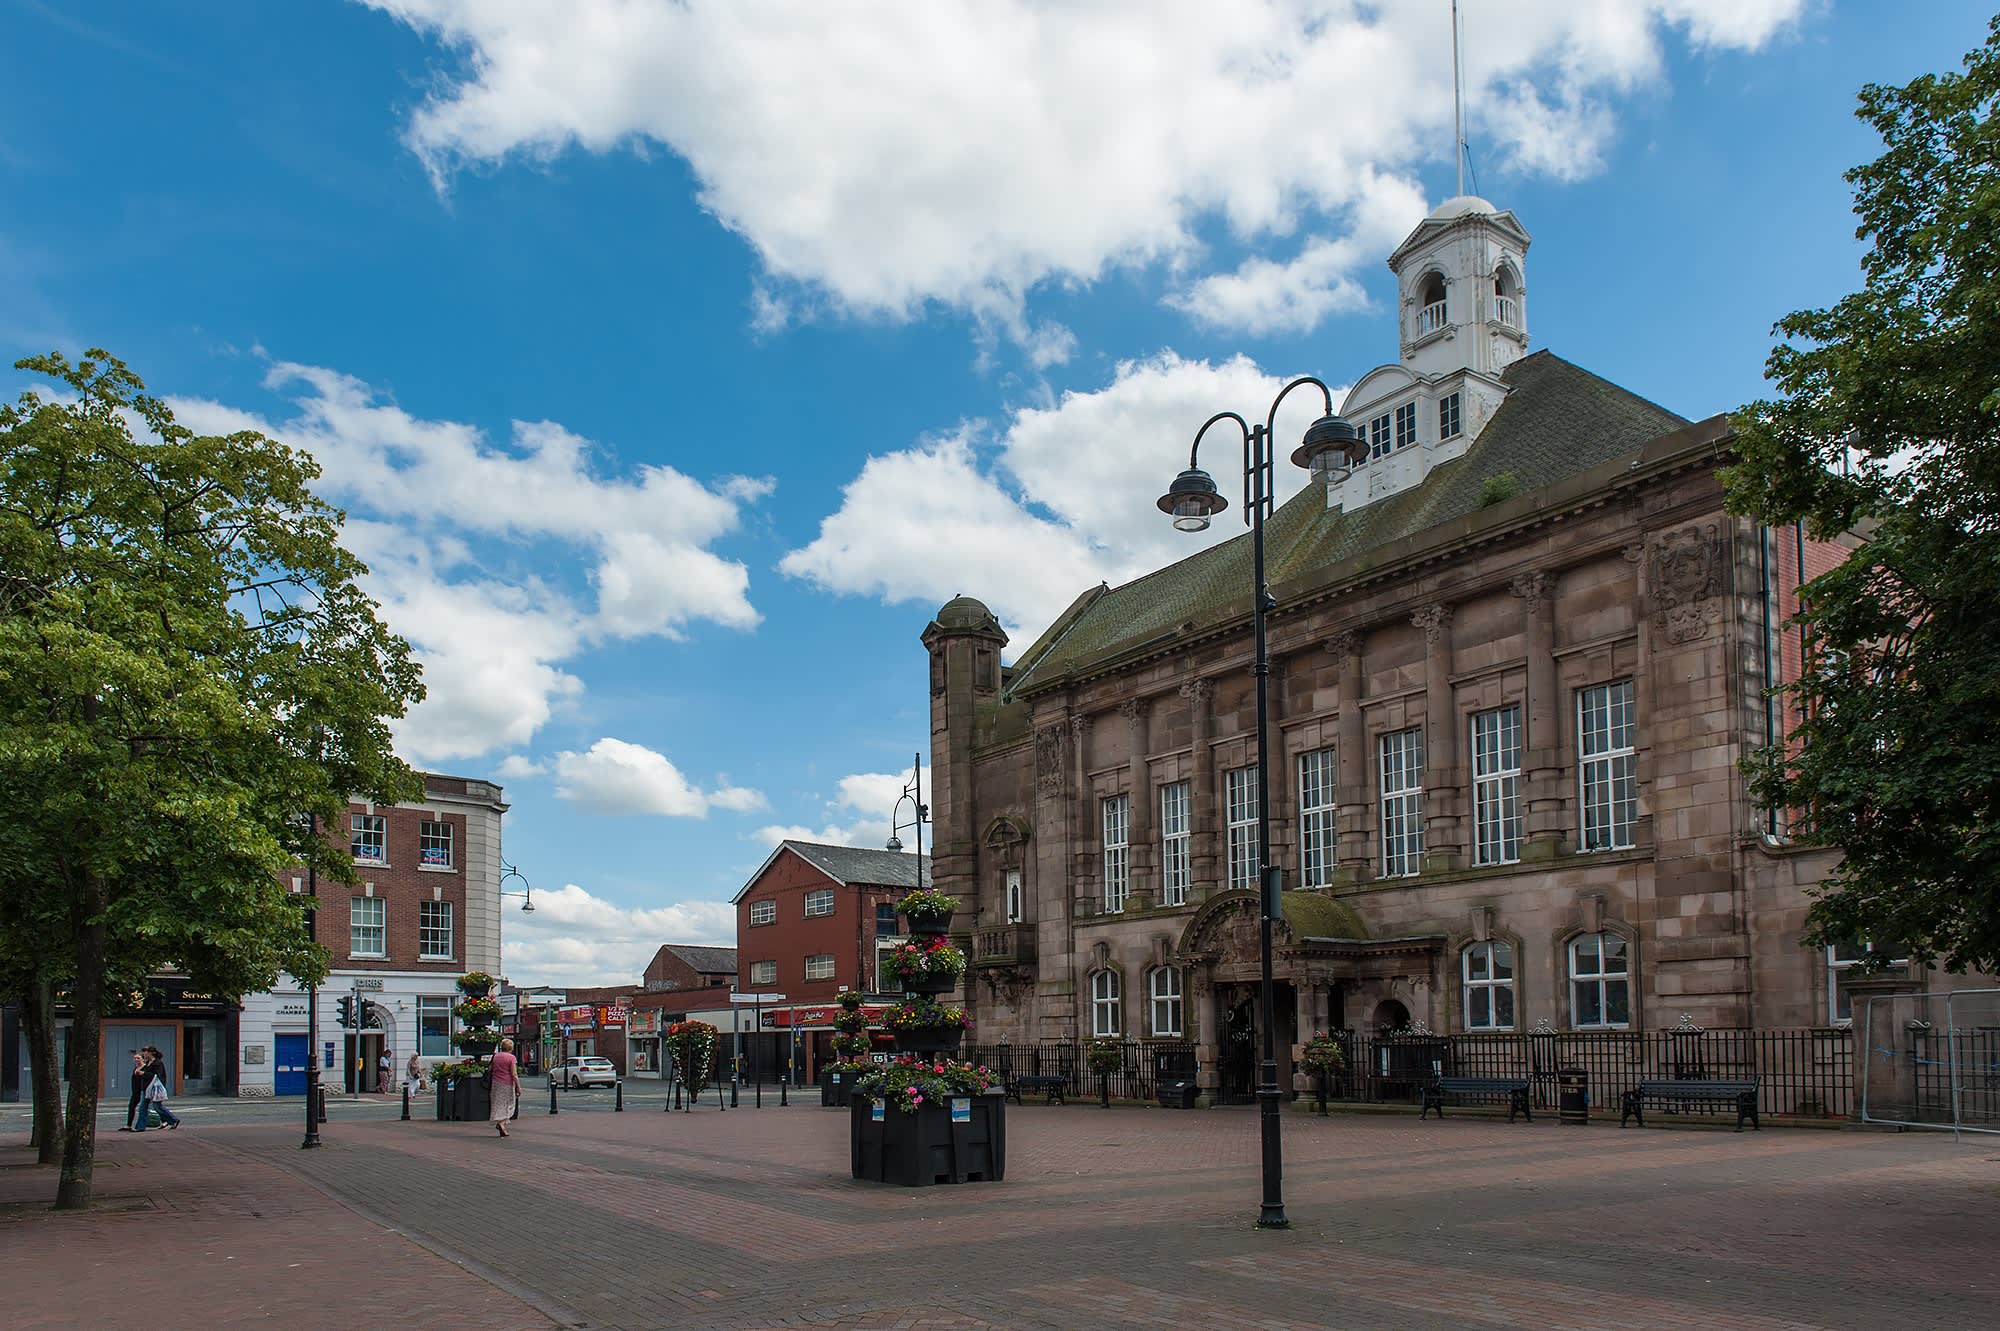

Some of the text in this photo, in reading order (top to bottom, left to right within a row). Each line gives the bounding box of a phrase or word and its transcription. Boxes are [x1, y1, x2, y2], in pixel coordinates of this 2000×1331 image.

[365, 979, 383, 987] RBS
[182, 990, 213, 999] Service
[873, 1055, 884, 1063] £5
